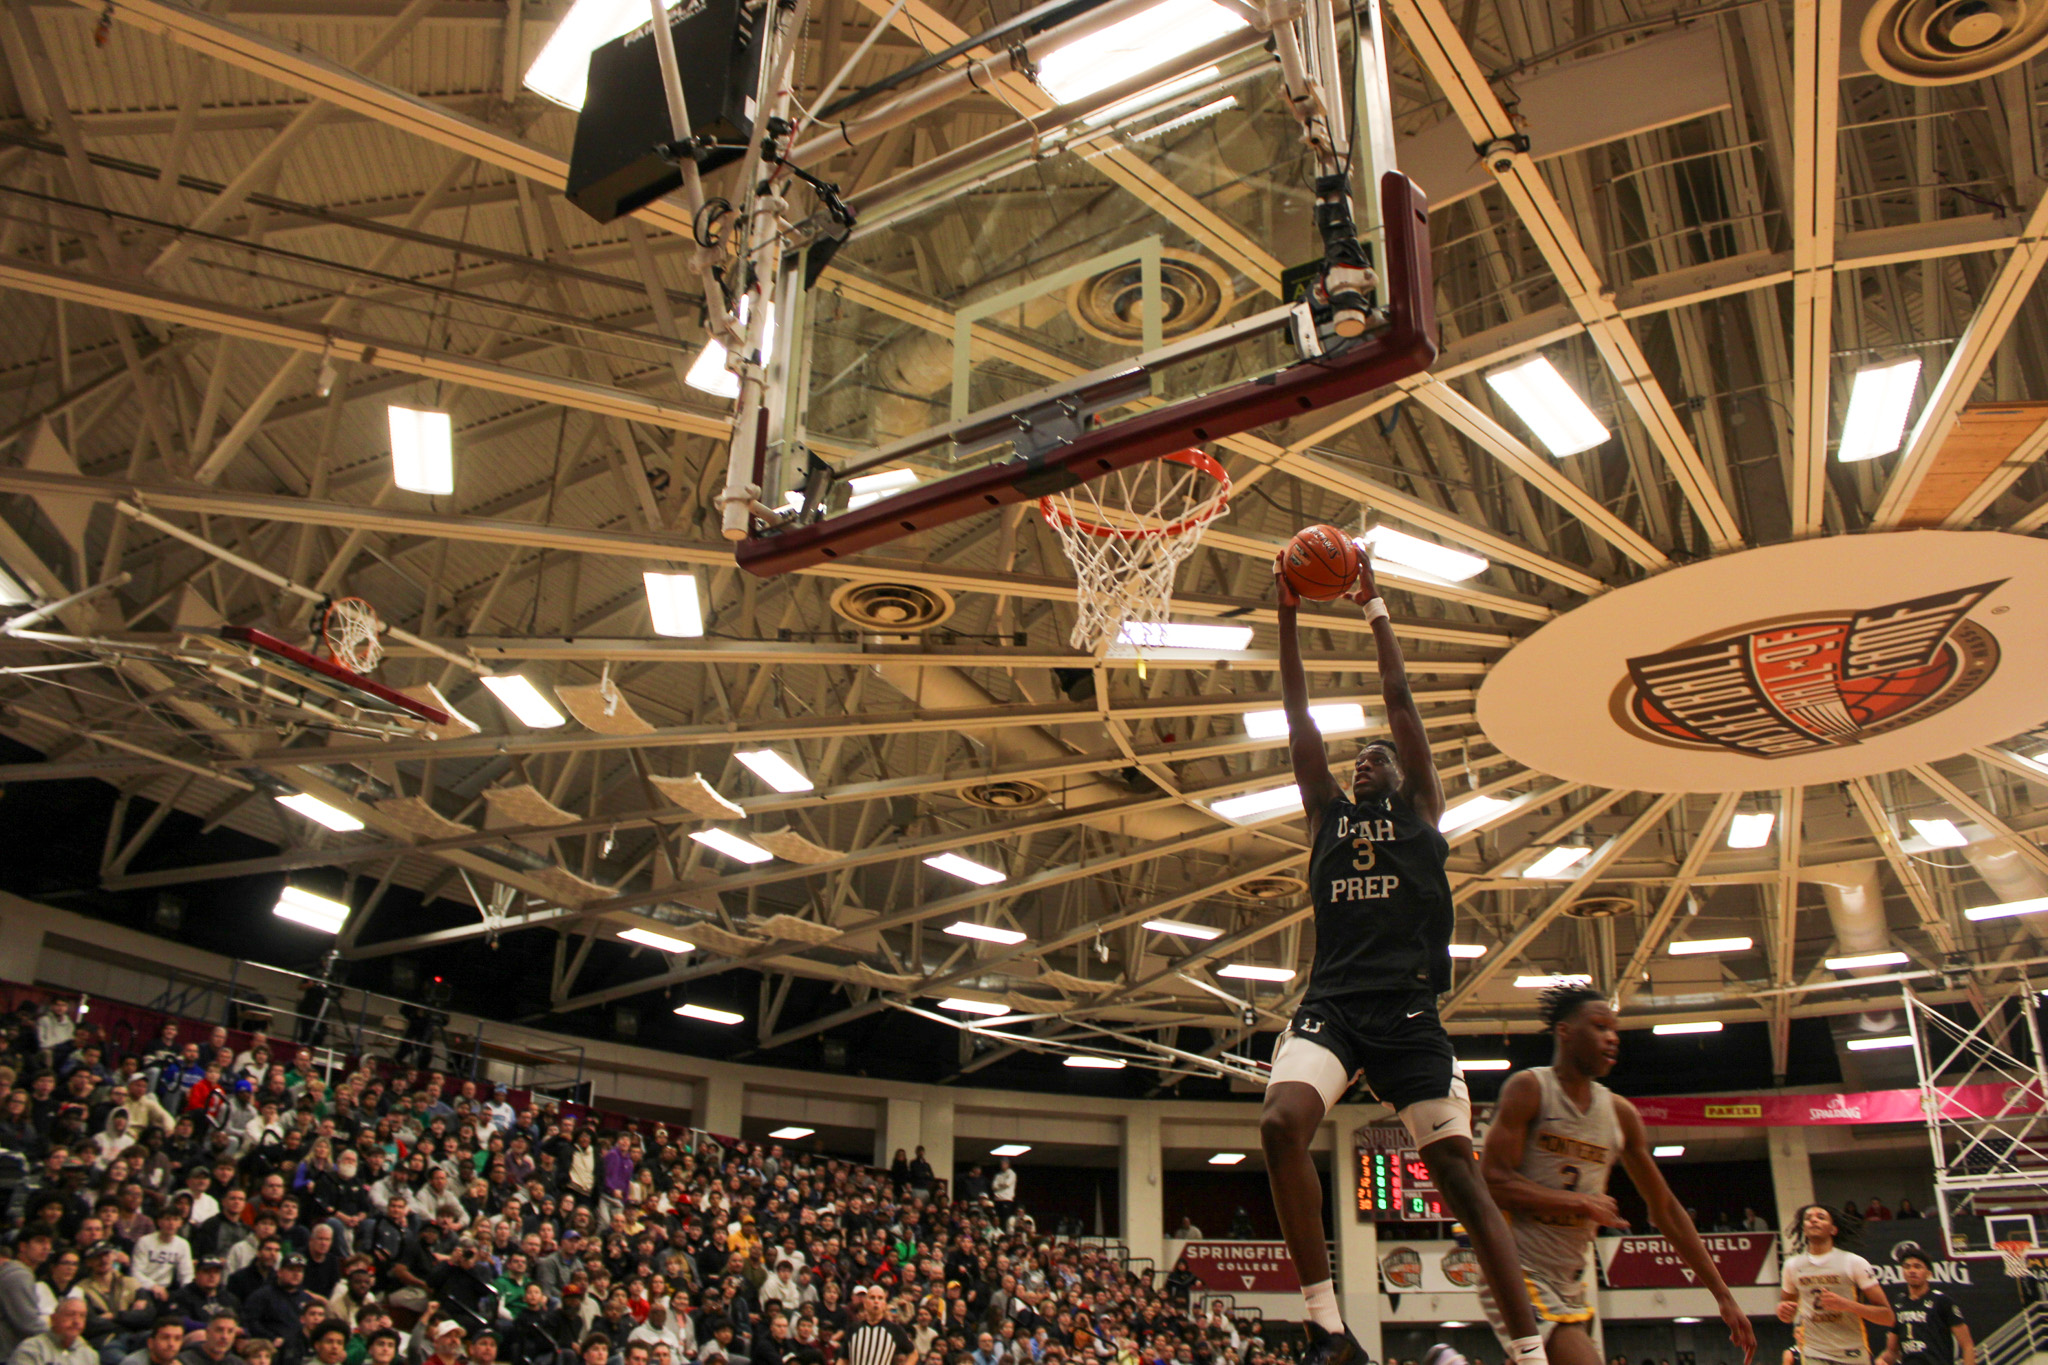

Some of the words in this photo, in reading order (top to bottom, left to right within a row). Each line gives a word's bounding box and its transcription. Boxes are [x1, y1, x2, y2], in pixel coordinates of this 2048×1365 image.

[1848, 592, 1984, 677] FAME
[1640, 644, 1819, 753] BASKETBALL
[1352, 837, 1376, 871] 3
[1331, 875, 1399, 903] PREP
[1708, 1107, 1758, 1115] PANINI
[1809, 1106, 1861, 1120] SPALDING
[1186, 1246, 1293, 1260] SPRINGFIEL
[1622, 1237, 1751, 1254] SPRIIELD
[148, 1250, 178, 1264] LSU
[1655, 1254, 1721, 1265] COLE
[1216, 1262, 1279, 1271] COLLEGE
[1868, 1259, 1975, 1286] PALNG
